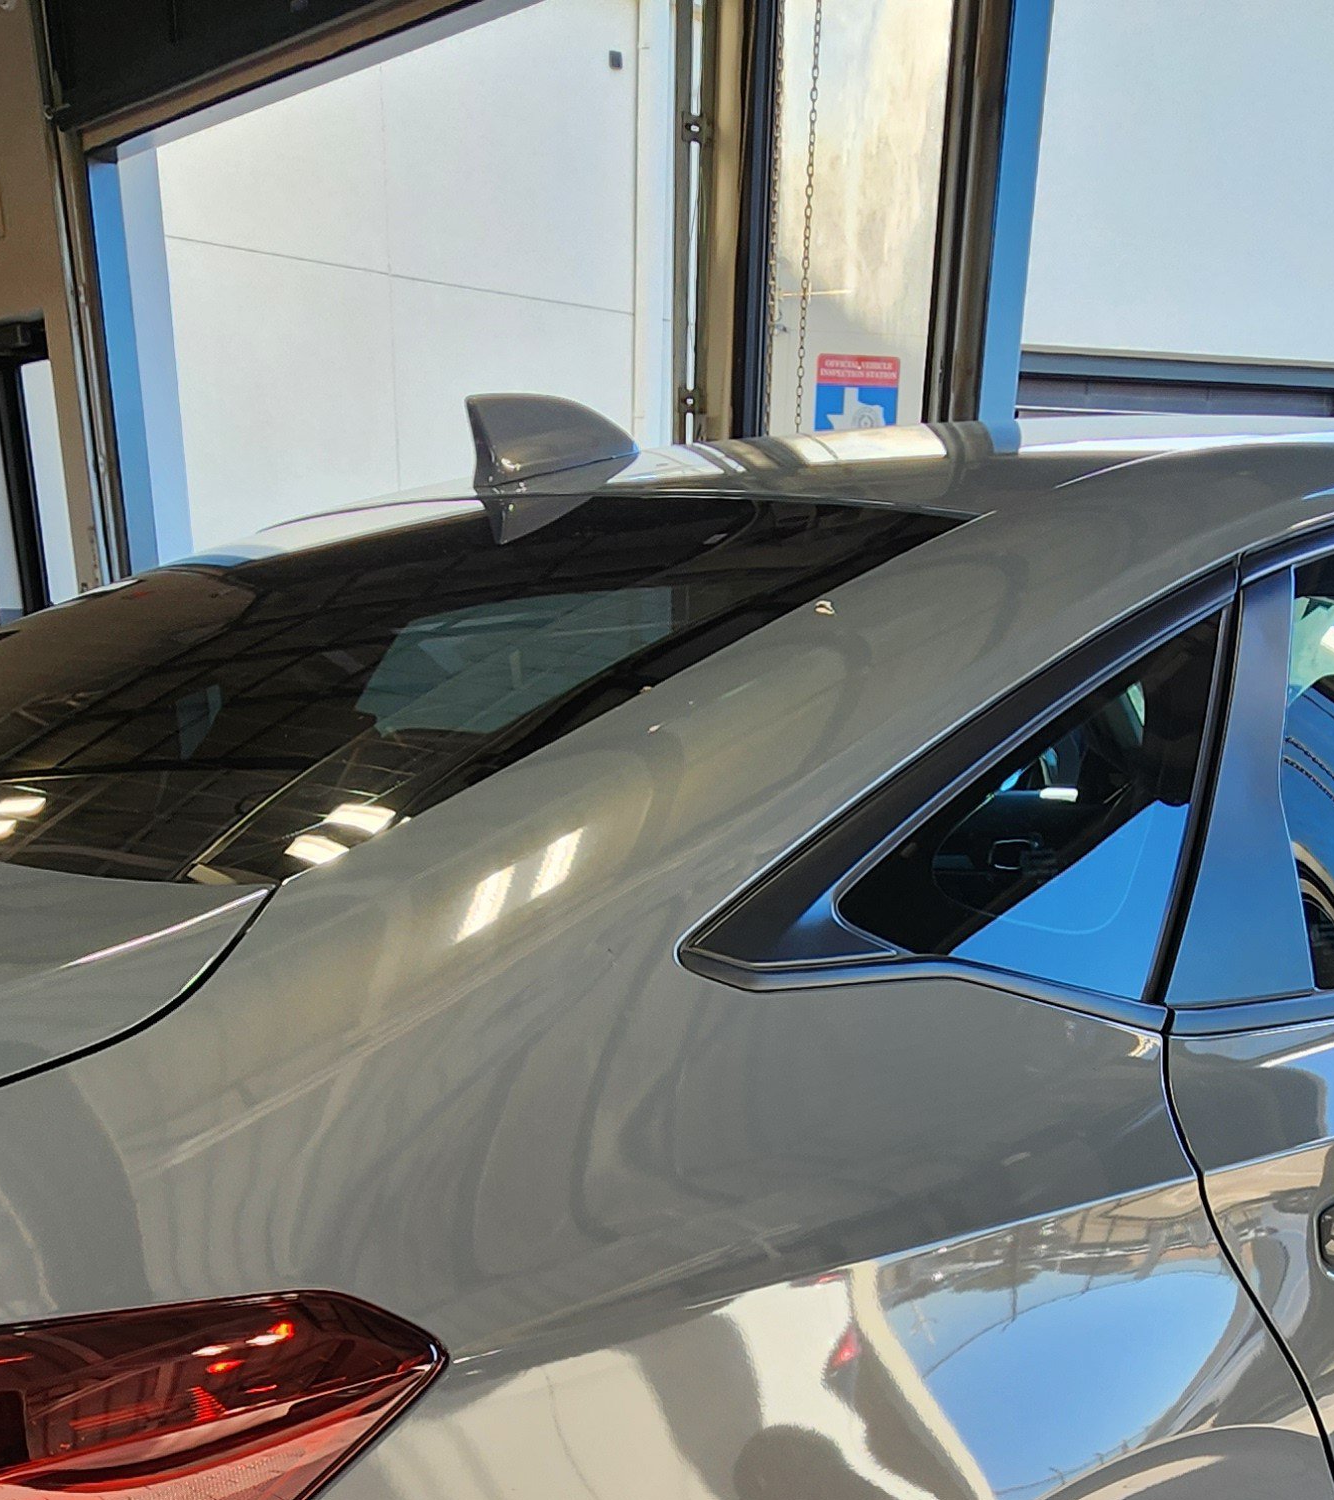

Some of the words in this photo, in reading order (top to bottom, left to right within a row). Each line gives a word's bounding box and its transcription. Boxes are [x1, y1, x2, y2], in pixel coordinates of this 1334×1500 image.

[861, 361, 893, 370] VEHICLE
[820, 368, 865, 378] INSPECTION
[866, 370, 898, 380] STATION
